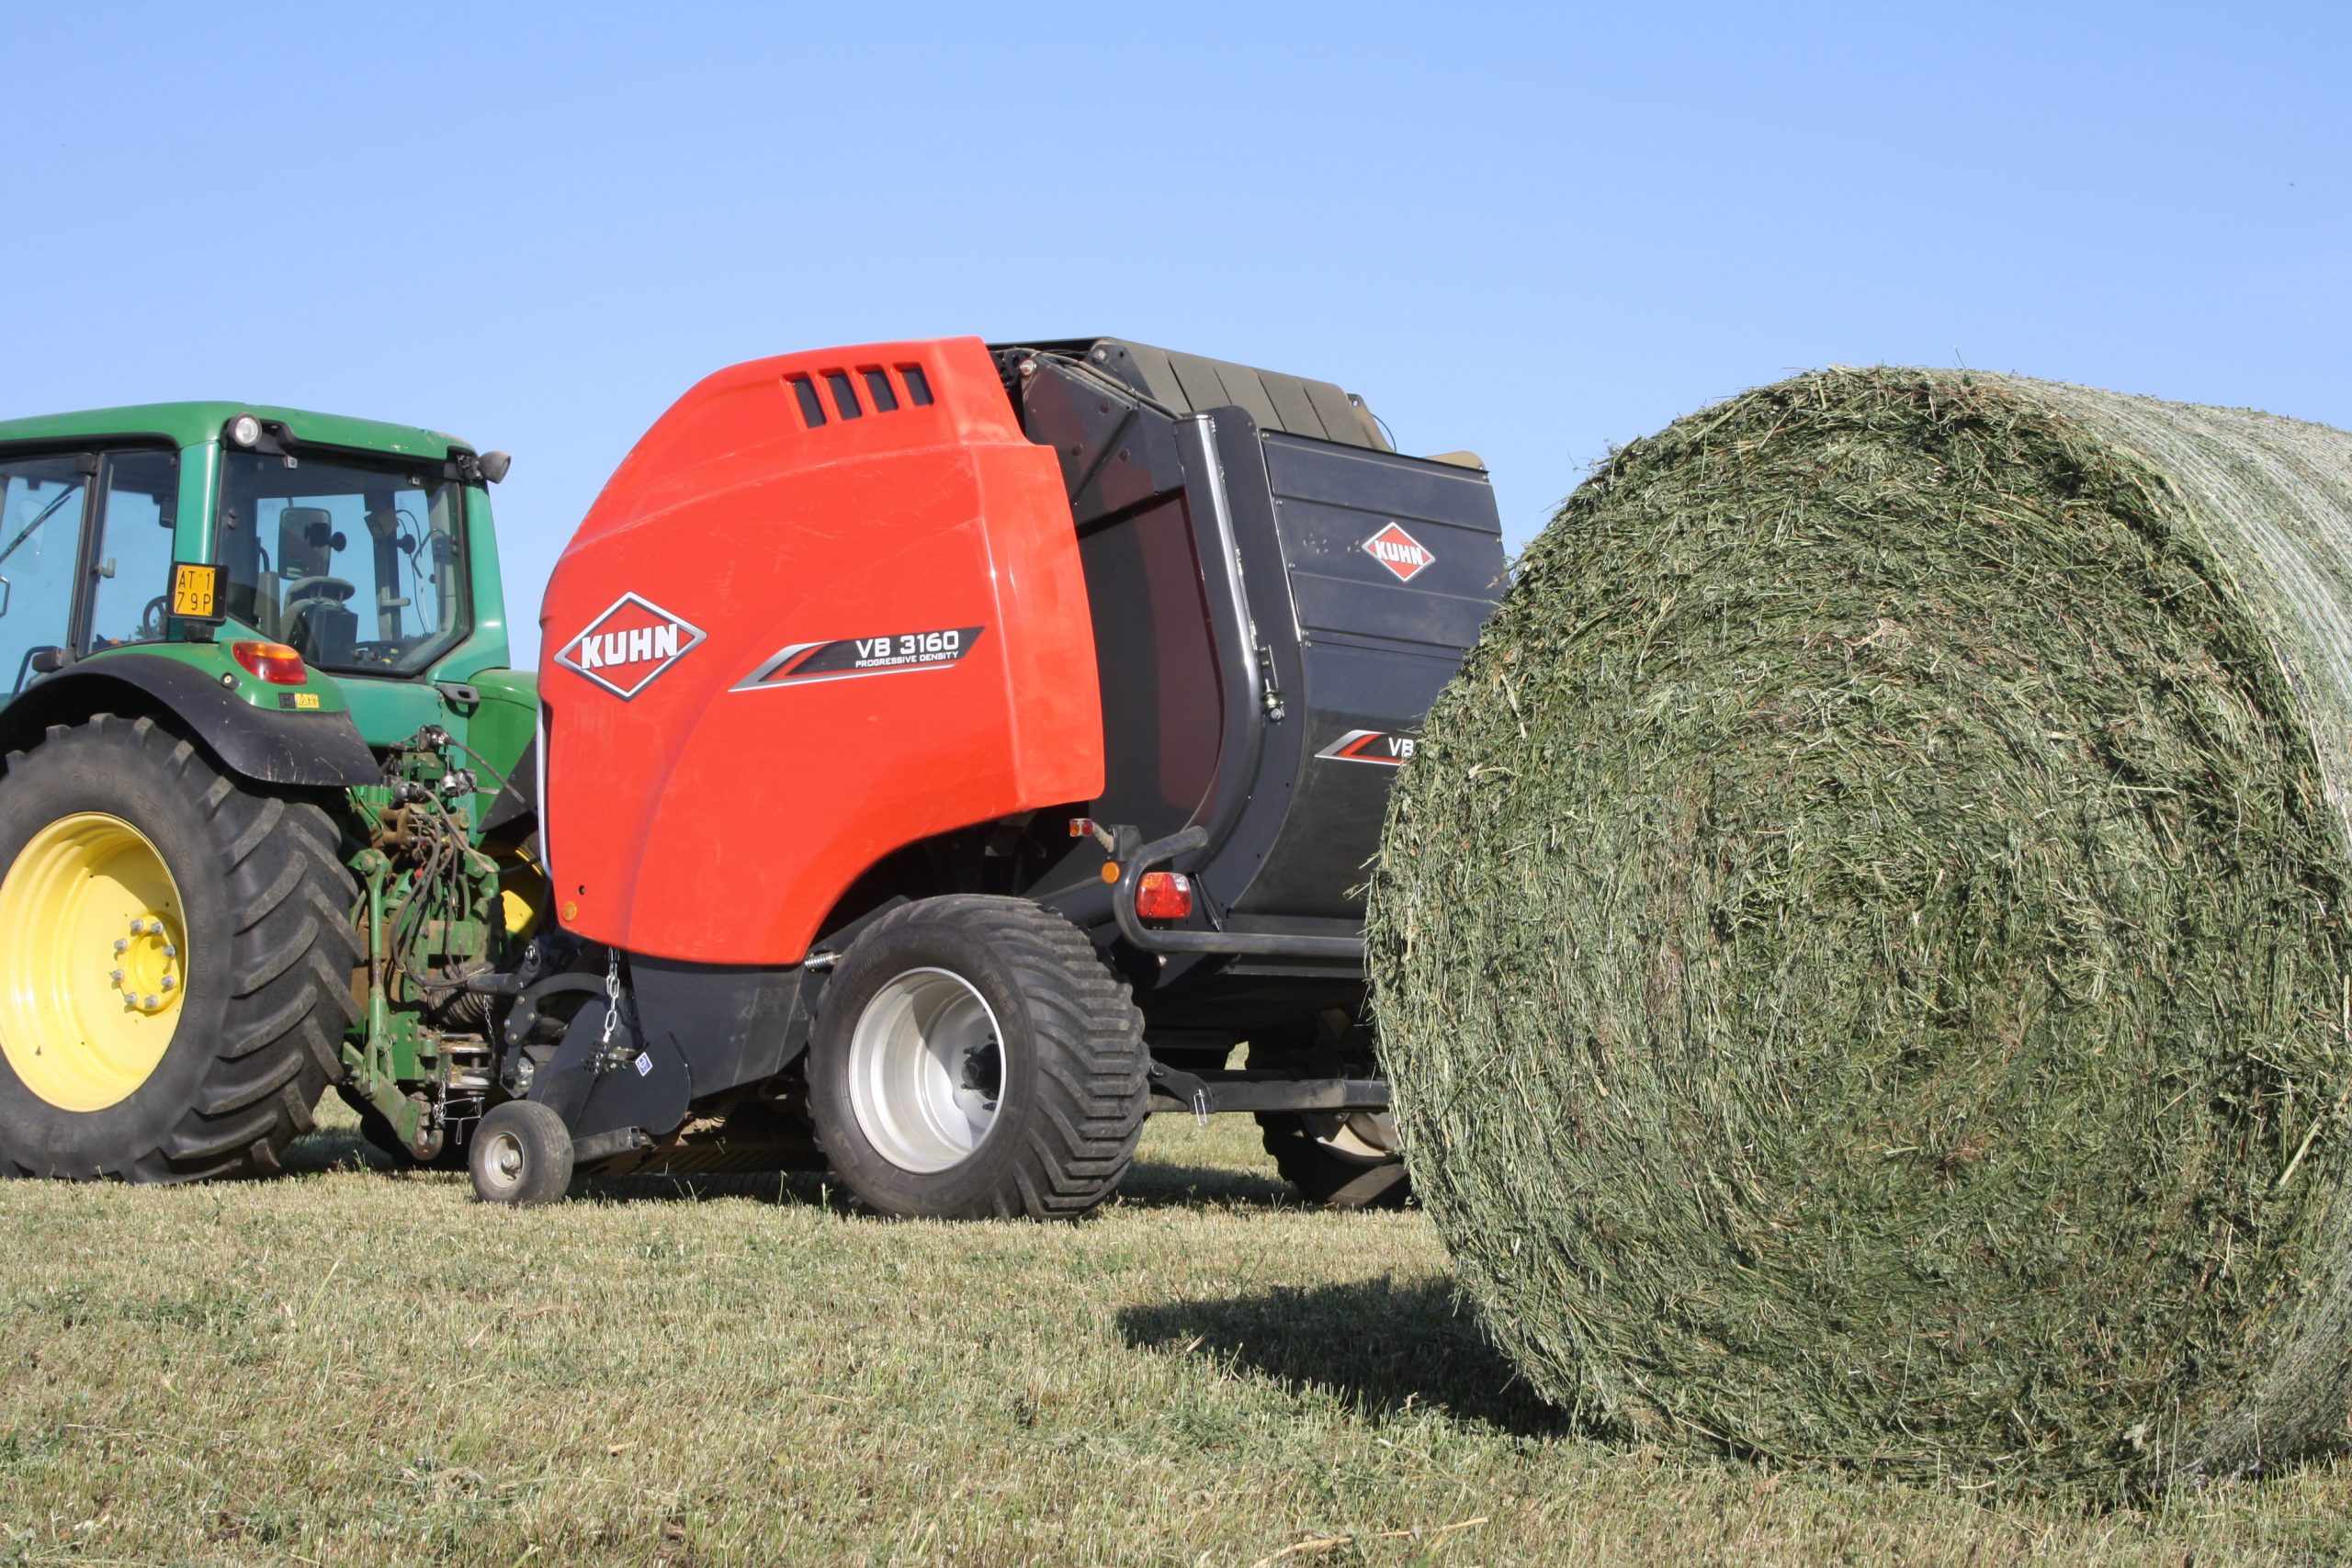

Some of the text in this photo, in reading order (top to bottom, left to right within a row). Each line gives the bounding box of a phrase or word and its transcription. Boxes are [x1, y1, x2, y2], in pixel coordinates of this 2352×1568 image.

[1374, 540, 1424, 566] KUHN
[178, 570, 210, 591] AT 1
[582, 623, 677, 670] KUHN
[855, 630, 959, 659] VB 3160
[855, 651, 959, 668] PROGRESSIVE DENSITY
[1388, 737, 1415, 758] VB
